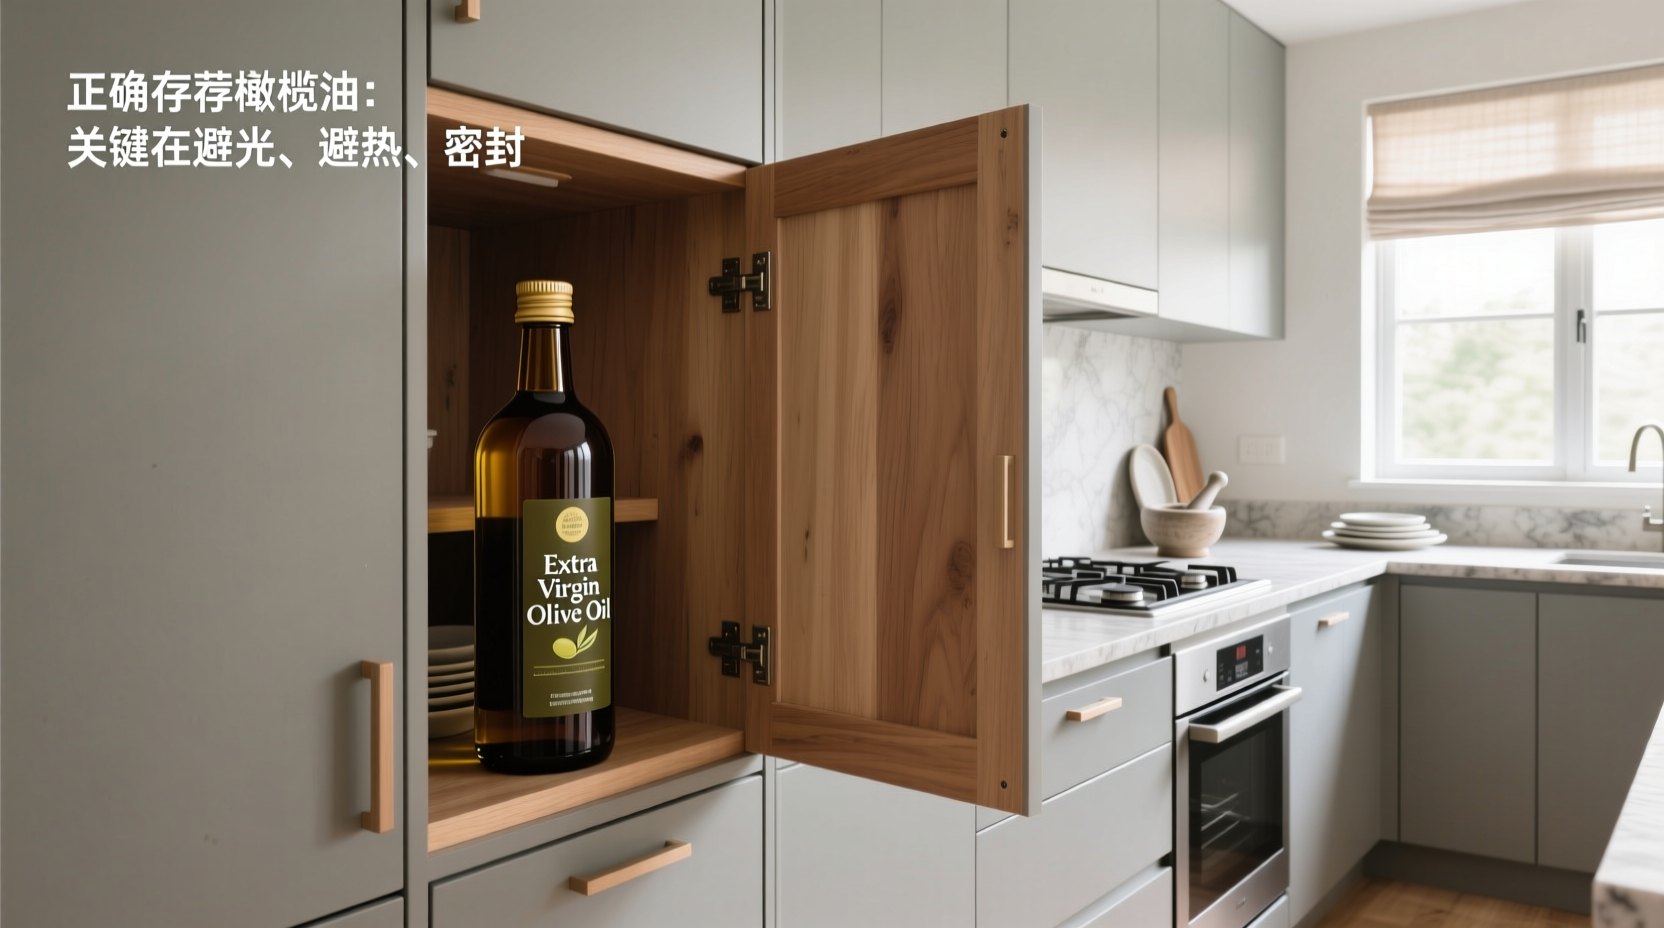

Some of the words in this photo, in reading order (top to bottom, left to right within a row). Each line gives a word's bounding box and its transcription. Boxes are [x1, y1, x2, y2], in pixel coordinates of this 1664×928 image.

[543, 553, 598, 575] Extra
[537, 576, 600, 604] Virgin
[526, 603, 582, 626] Olive
[585, 597, 611, 622] Oil
